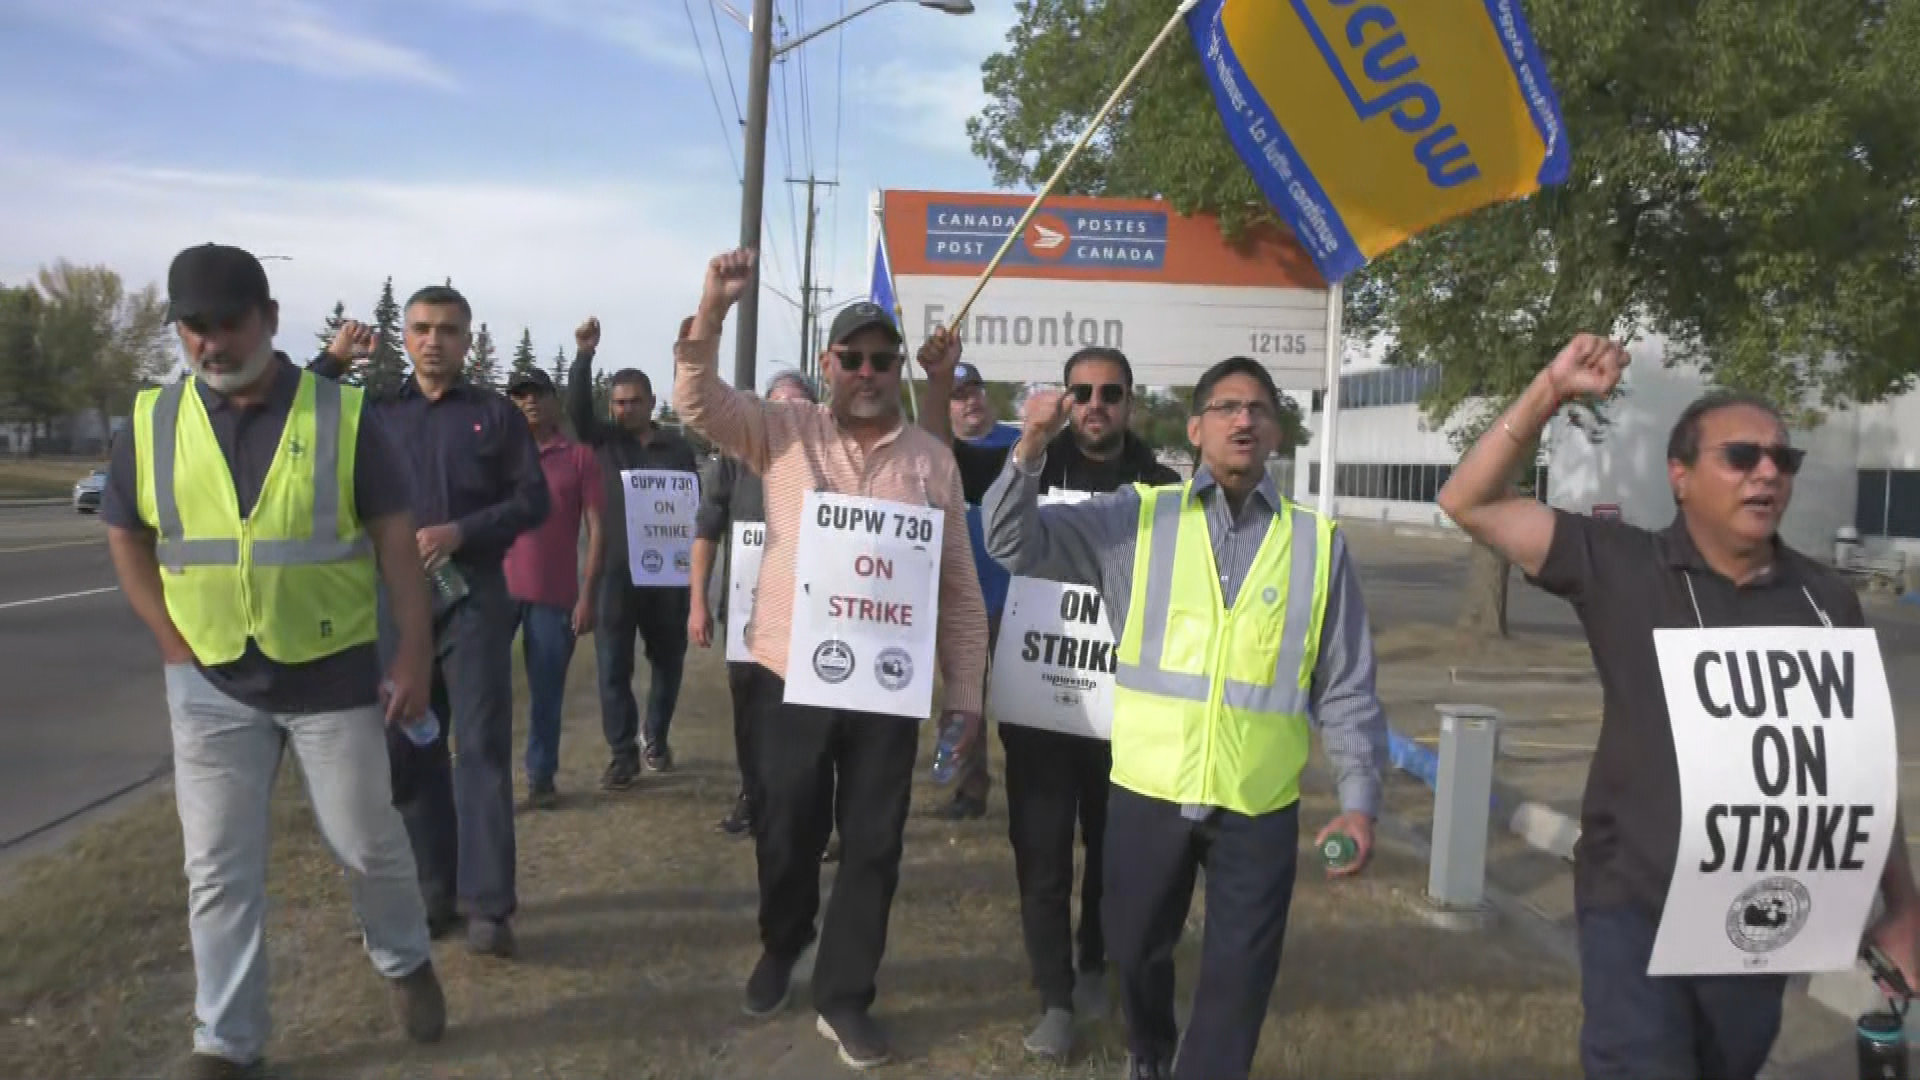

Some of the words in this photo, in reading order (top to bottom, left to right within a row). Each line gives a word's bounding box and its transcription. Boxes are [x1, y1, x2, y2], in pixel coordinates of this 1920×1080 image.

[1328, 0, 1481, 188] cupw
[938, 212, 1017, 228] CANADA
[1078, 217, 1146, 233] POSTES
[1288, 180, 1338, 253] continue
[937, 241, 985, 255] POST
[1077, 246, 1155, 261] CANADA
[1249, 333, 1306, 355] 12135
[631, 475, 666, 490] CUPW
[654, 501, 675, 515] ON
[644, 523, 689, 540] STRIKE
[817, 504, 885, 535] CUPW
[892, 513, 933, 543] 730
[743, 529, 763, 547] CU
[855, 555, 893, 579] ON
[828, 595, 913, 627] STRIKE
[1060, 590, 1101, 625] ON
[1693, 650, 1856, 720] CUPW
[1751, 725, 1829, 798] ON
[1699, 804, 1875, 873] STRIKE
